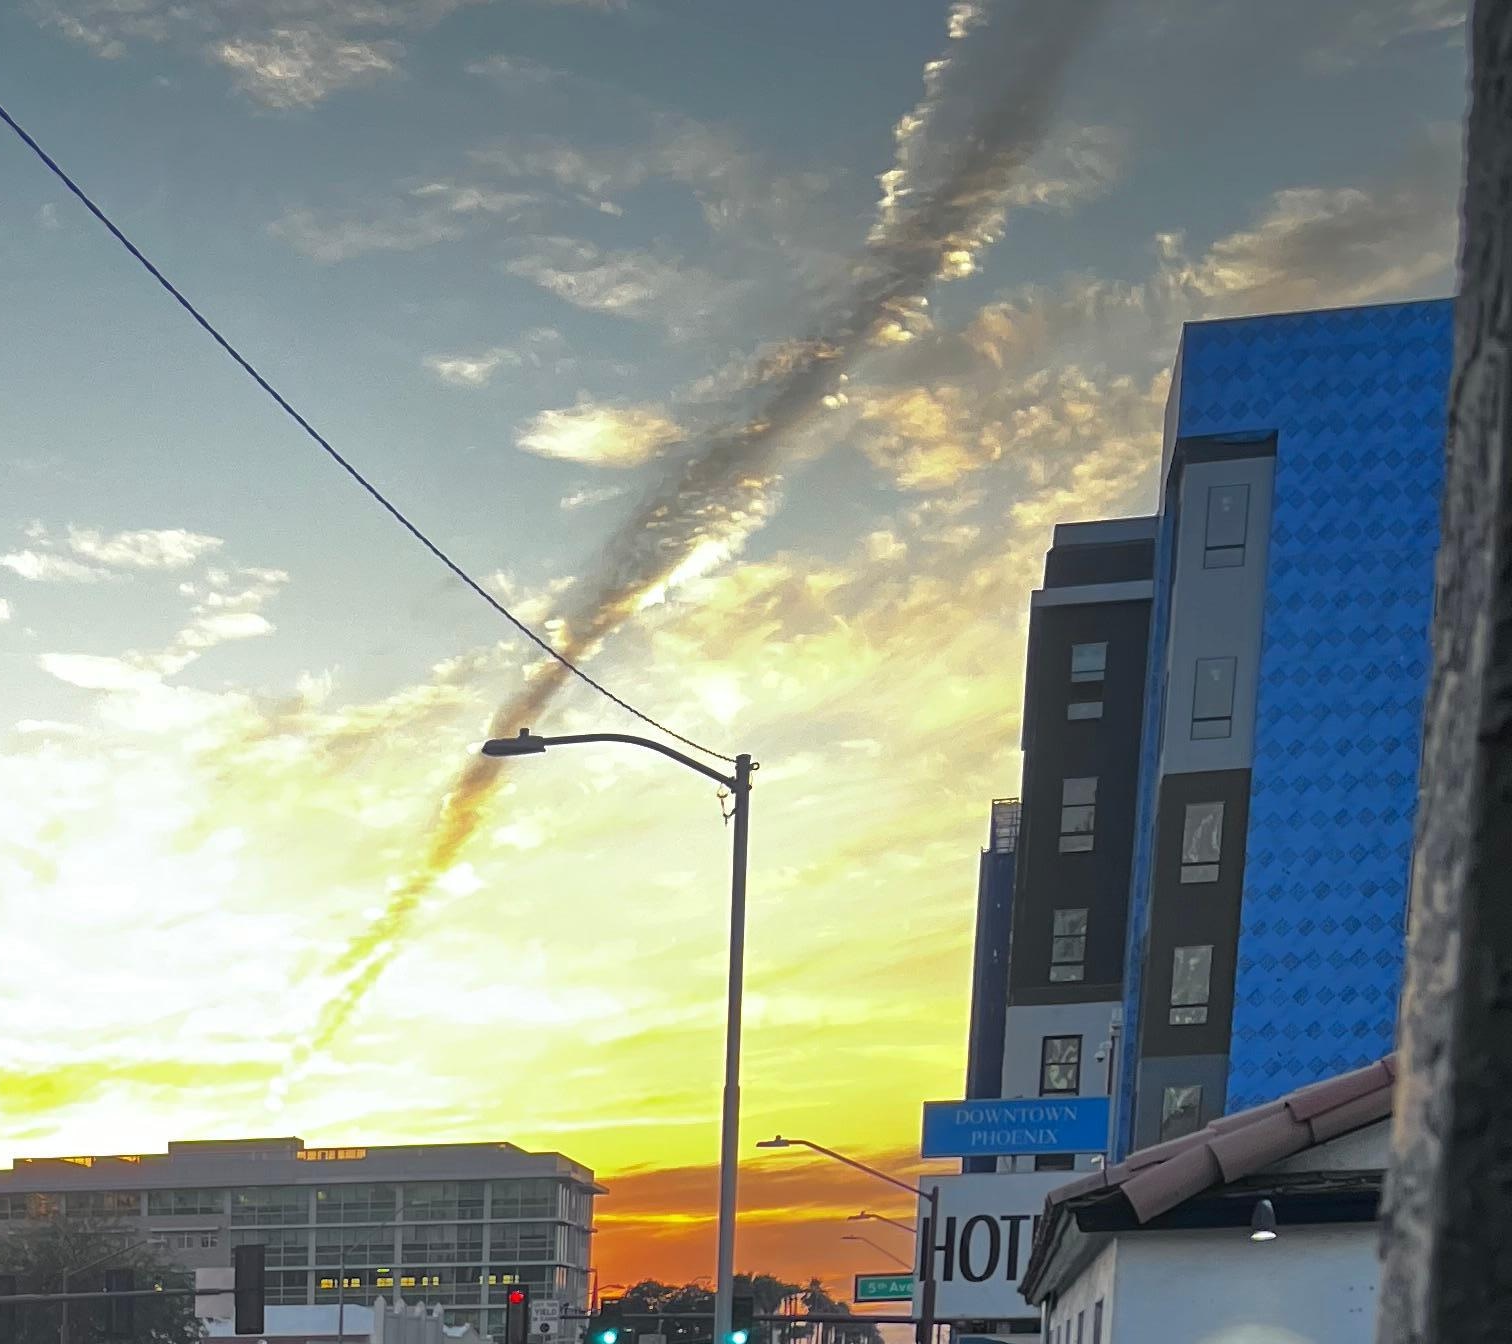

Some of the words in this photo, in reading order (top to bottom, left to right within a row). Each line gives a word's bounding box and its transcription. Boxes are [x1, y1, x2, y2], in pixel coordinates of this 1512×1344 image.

[955, 1106, 1078, 1125] DOWNTOWN
[970, 1128, 1058, 1146] PHOENIX
[919, 1214, 1043, 1282] HOT
[868, 1281, 888, 1294] 5th
